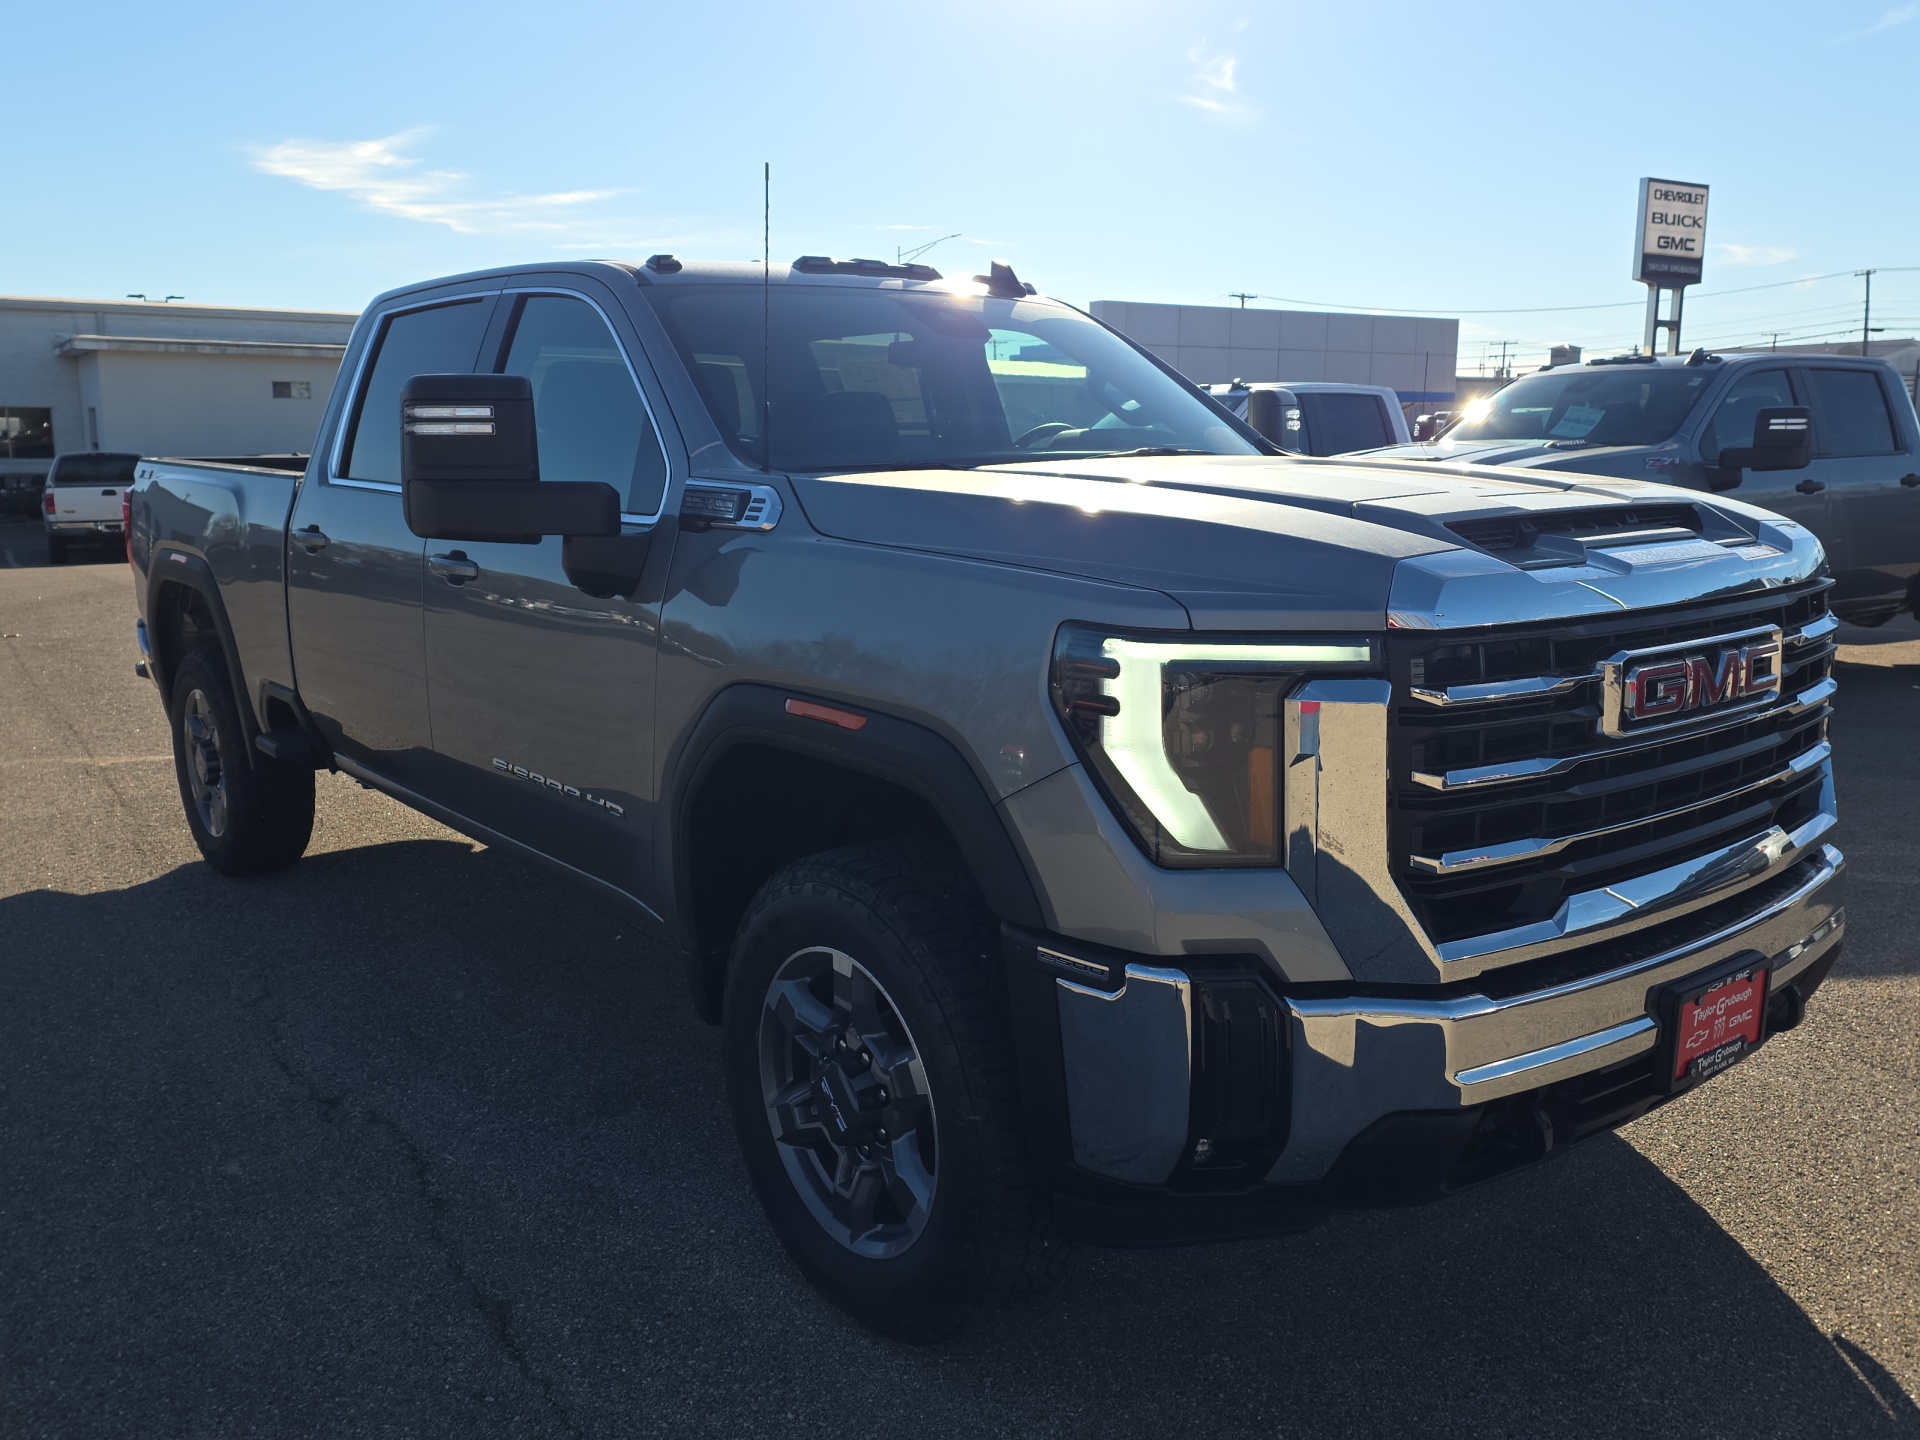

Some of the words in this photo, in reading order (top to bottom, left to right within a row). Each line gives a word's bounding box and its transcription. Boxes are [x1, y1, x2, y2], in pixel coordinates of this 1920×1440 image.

[1654, 188, 1705, 205] CHEVROLET
[1651, 211, 1703, 229] BUICK
[1657, 235, 1696, 252] GMC
[1648, 262, 1669, 272] TAYLOR
[1669, 263, 1699, 274] GRUBAUGH
[1625, 640, 1780, 720] GMC
[492, 757, 582, 800] SIERRA
[586, 793, 626, 818] HD
[1735, 969, 1750, 982] GMC
[1693, 1005, 1717, 1028] Taylor
[1716, 987, 1753, 1015] Grubaugh
[1729, 1009, 1753, 1028] GMC
[1698, 1054, 1716, 1073] Taylor
[1715, 1041, 1742, 1063] Grubaugh
